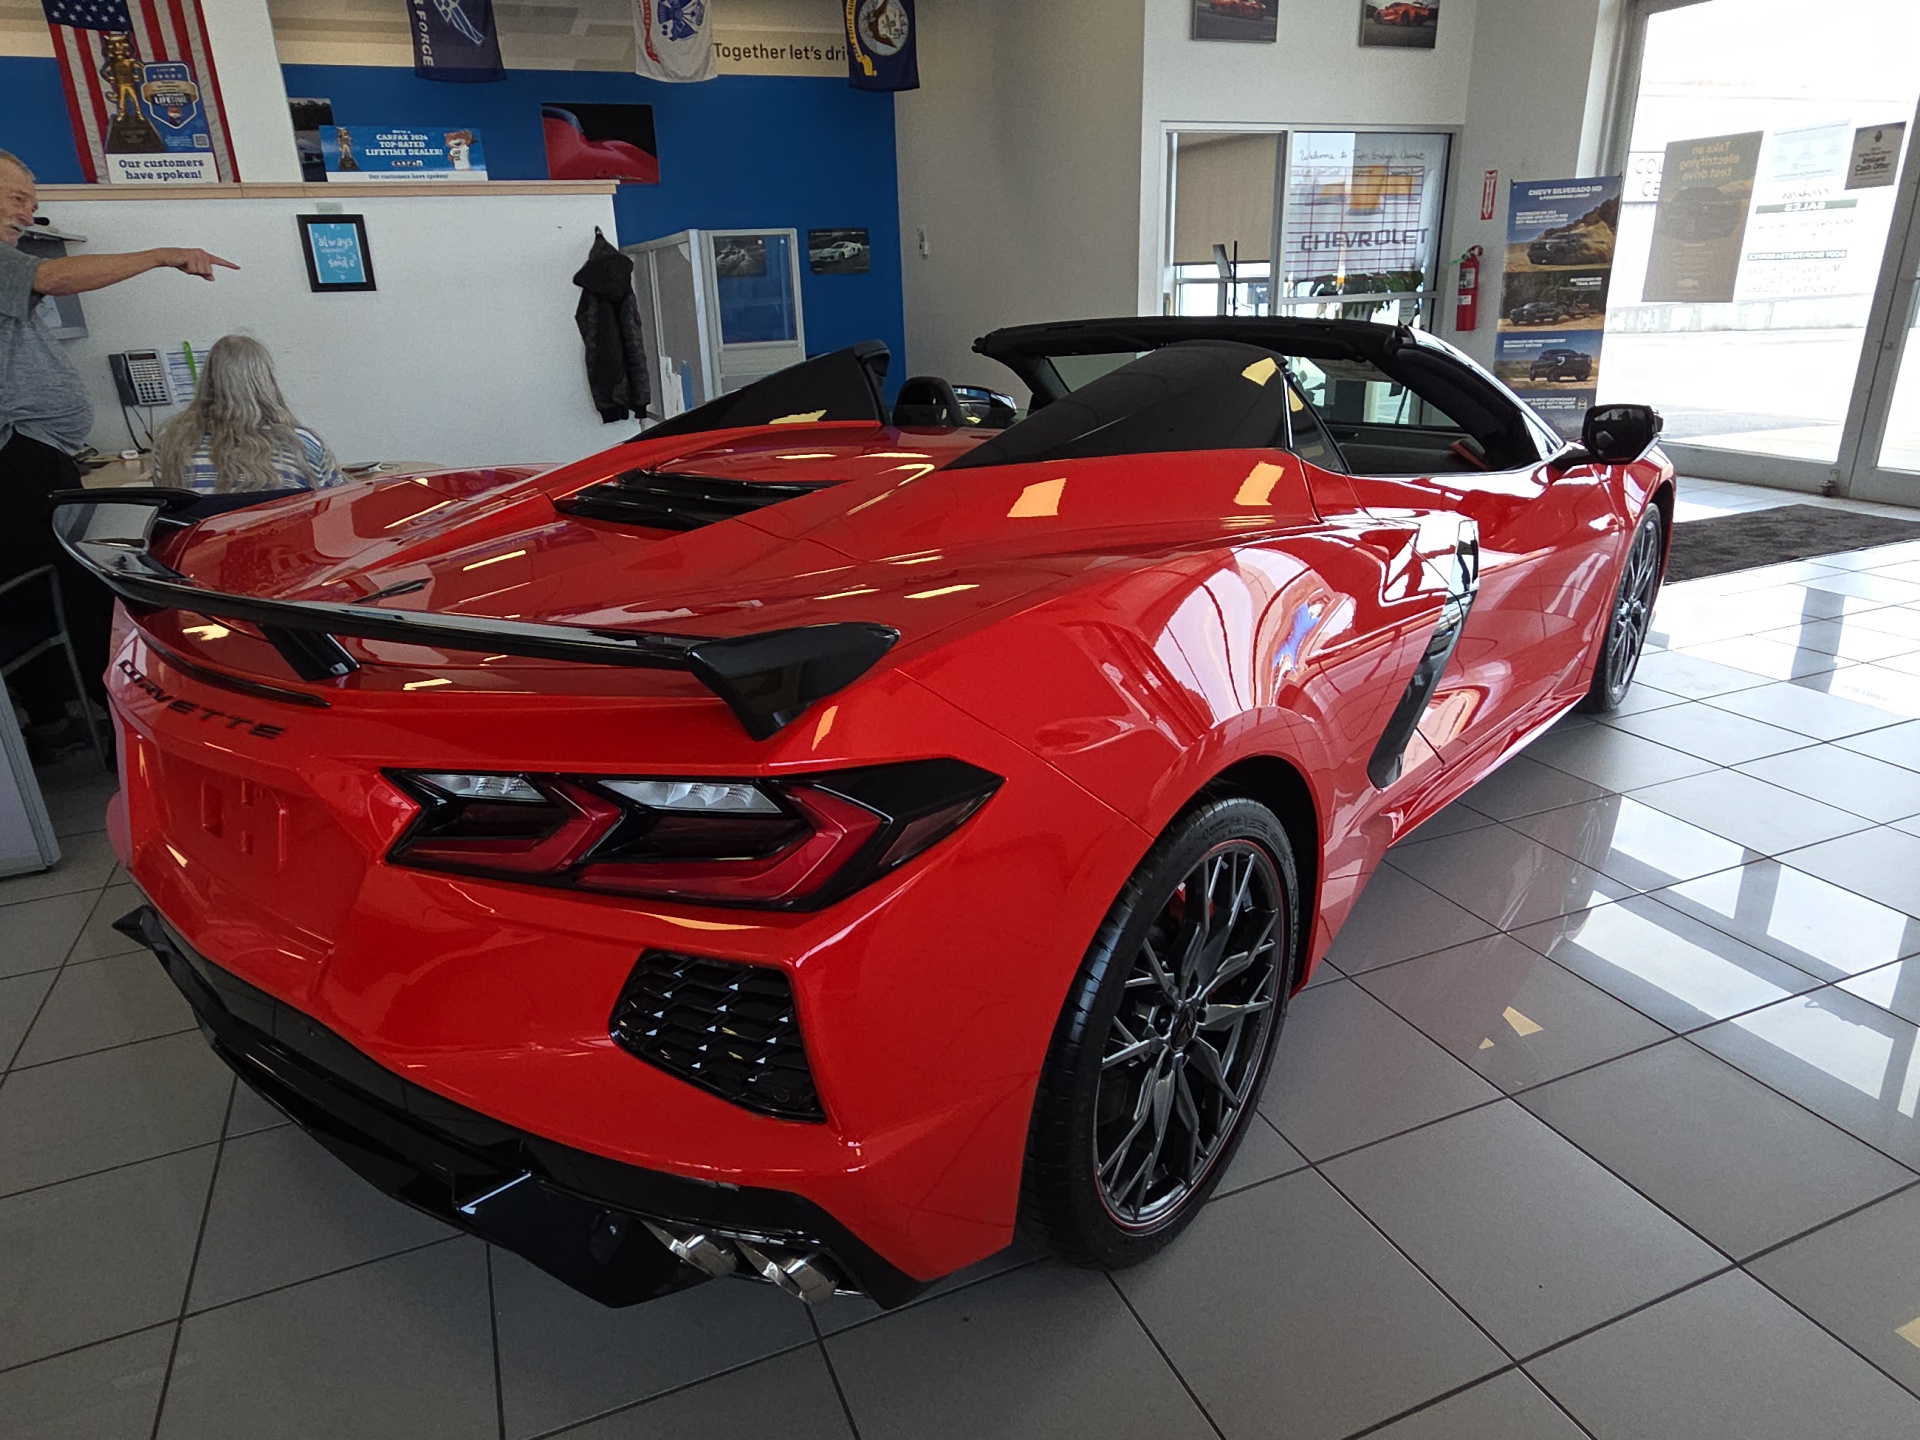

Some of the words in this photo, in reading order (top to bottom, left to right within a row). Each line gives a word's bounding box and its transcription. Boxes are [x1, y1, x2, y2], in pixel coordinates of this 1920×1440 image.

[416, 10, 435, 67] FORCE
[713, 43, 786, 62] Together
[789, 44, 822, 60] let's
[365, 148, 407, 156] LIFETIME
[408, 148, 444, 156] DEALER!
[119, 160, 141, 168] Our
[144, 159, 204, 168] customers
[125, 171, 154, 180] have
[157, 170, 202, 181] spoken!
[1528, 188, 1552, 196] CHEVY
[1552, 186, 1591, 195] SILVERADO
[318, 235, 354, 250] always
[1300, 228, 1429, 251] CHEVROLET
[118, 659, 285, 740] CORVETTE
